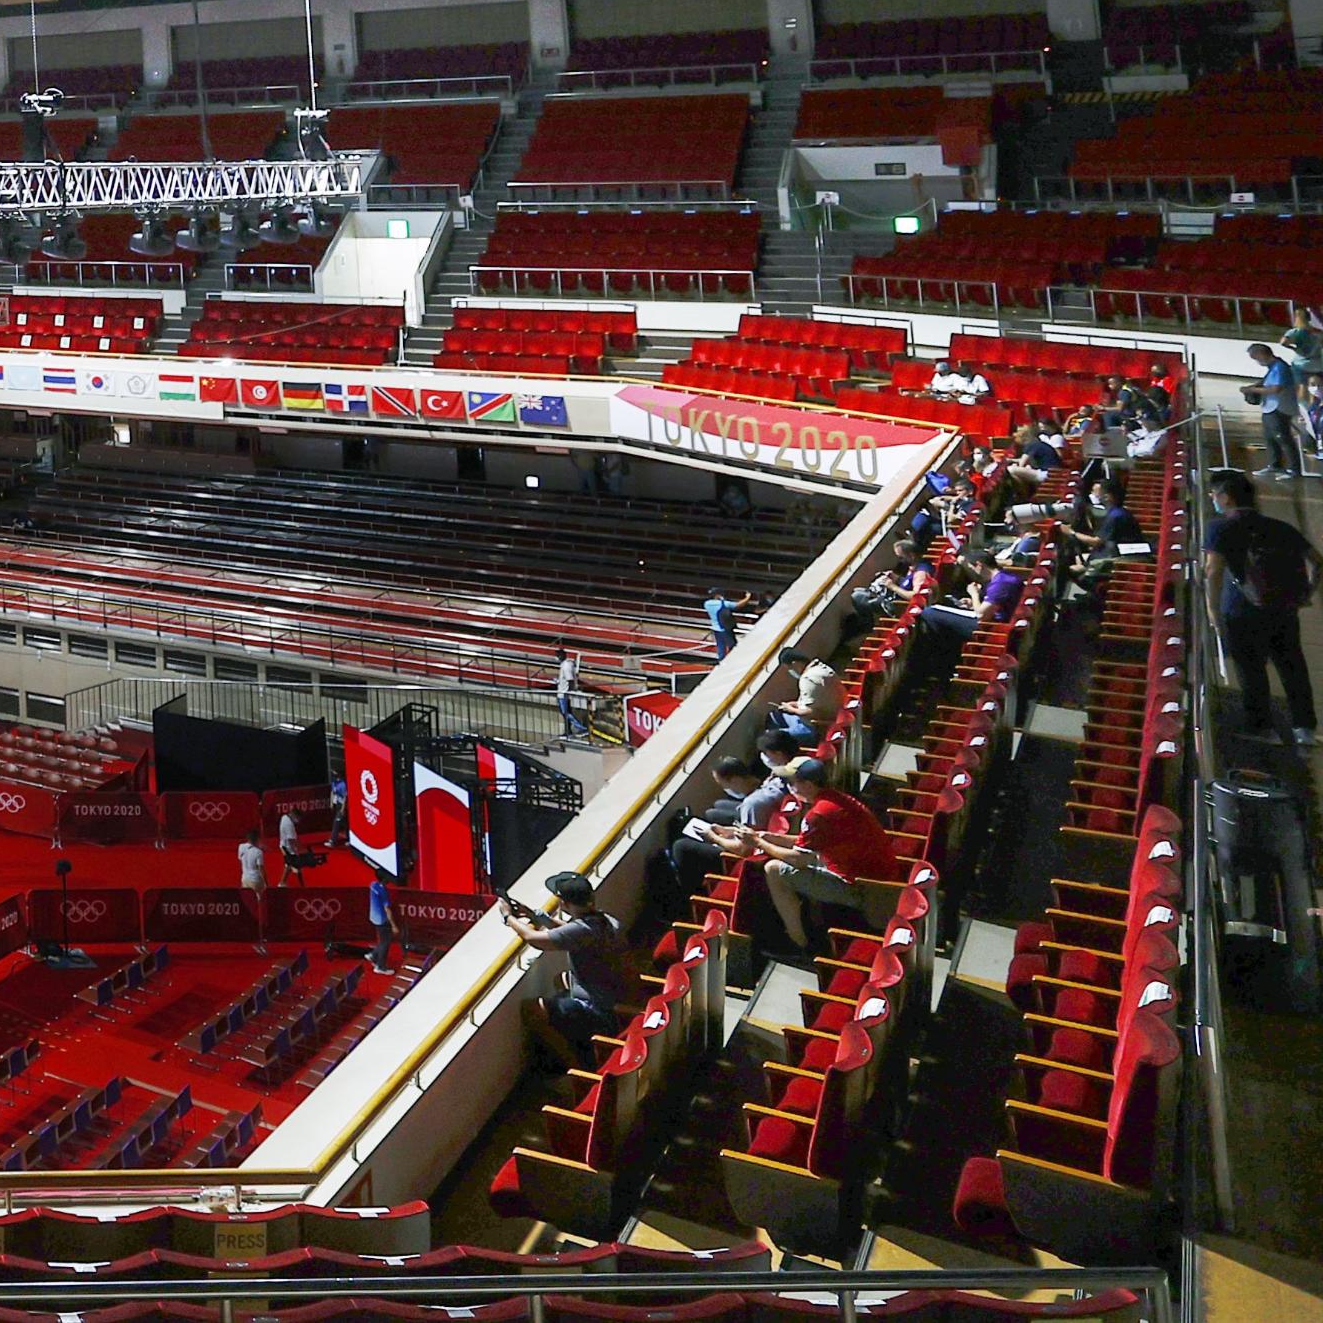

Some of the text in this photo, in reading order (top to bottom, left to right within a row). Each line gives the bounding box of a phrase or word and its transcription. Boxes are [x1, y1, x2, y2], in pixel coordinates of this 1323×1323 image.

[641, 402, 878, 484] TOKYO 2020
[74, 804, 141, 816] TOKYO 2020
[162, 903, 240, 916] TOKYO 2020
[399, 904, 446, 920] TOKYO
[217, 1234, 265, 1250] PRESS
